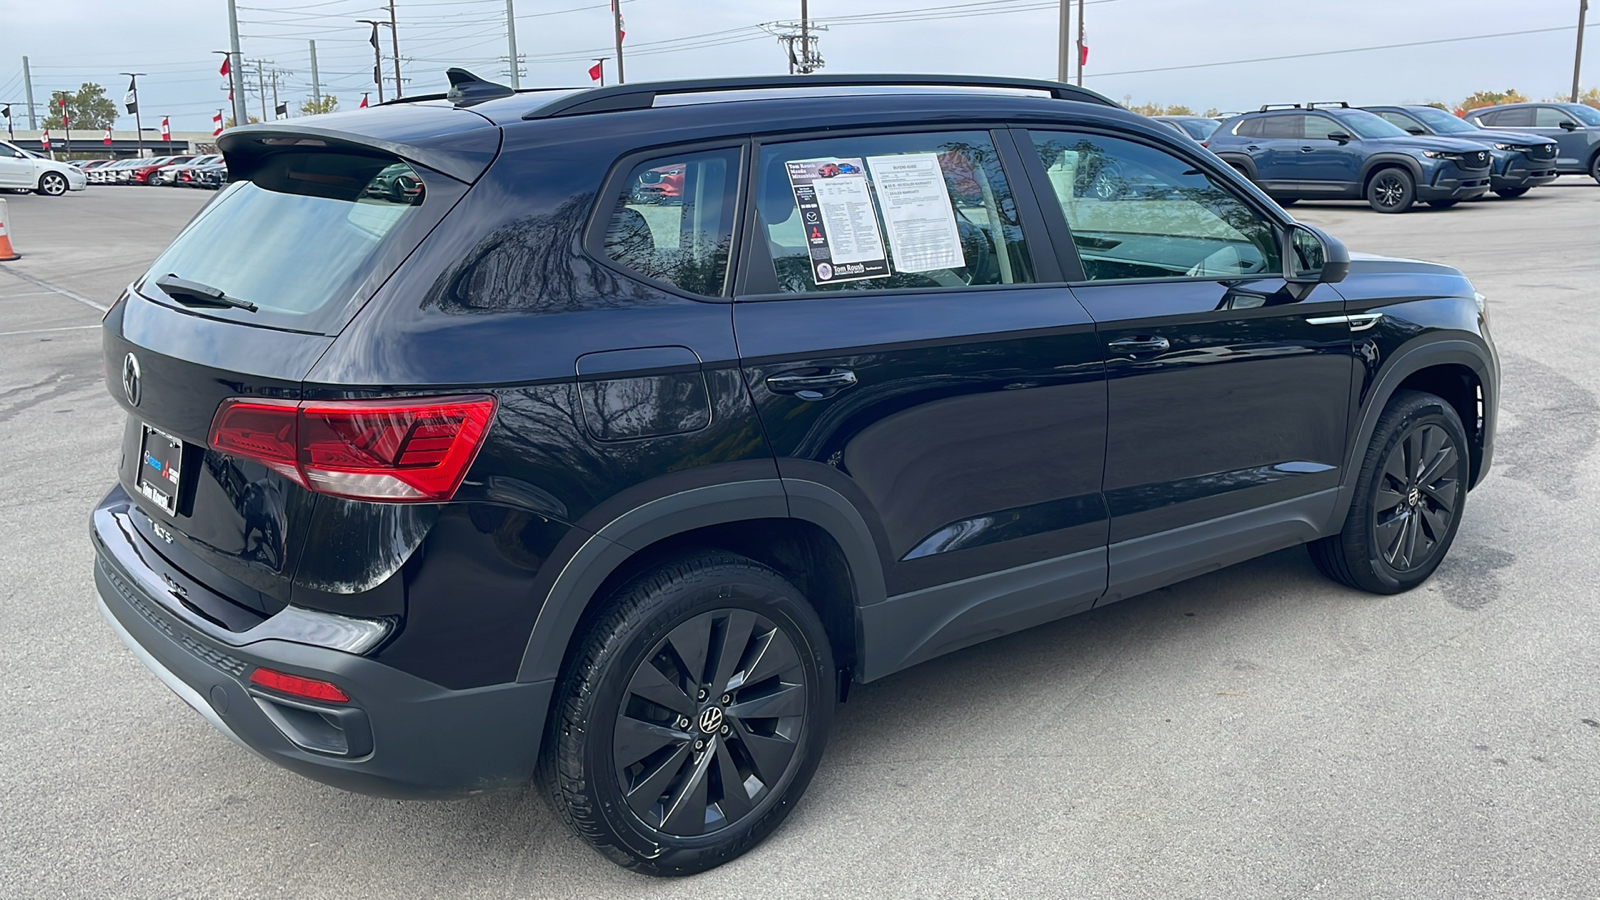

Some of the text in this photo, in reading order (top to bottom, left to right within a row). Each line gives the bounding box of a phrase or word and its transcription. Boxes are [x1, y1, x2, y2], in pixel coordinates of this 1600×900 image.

[833, 263, 864, 273] Tom Roush
[142, 481, 168, 511] Tom Roush
